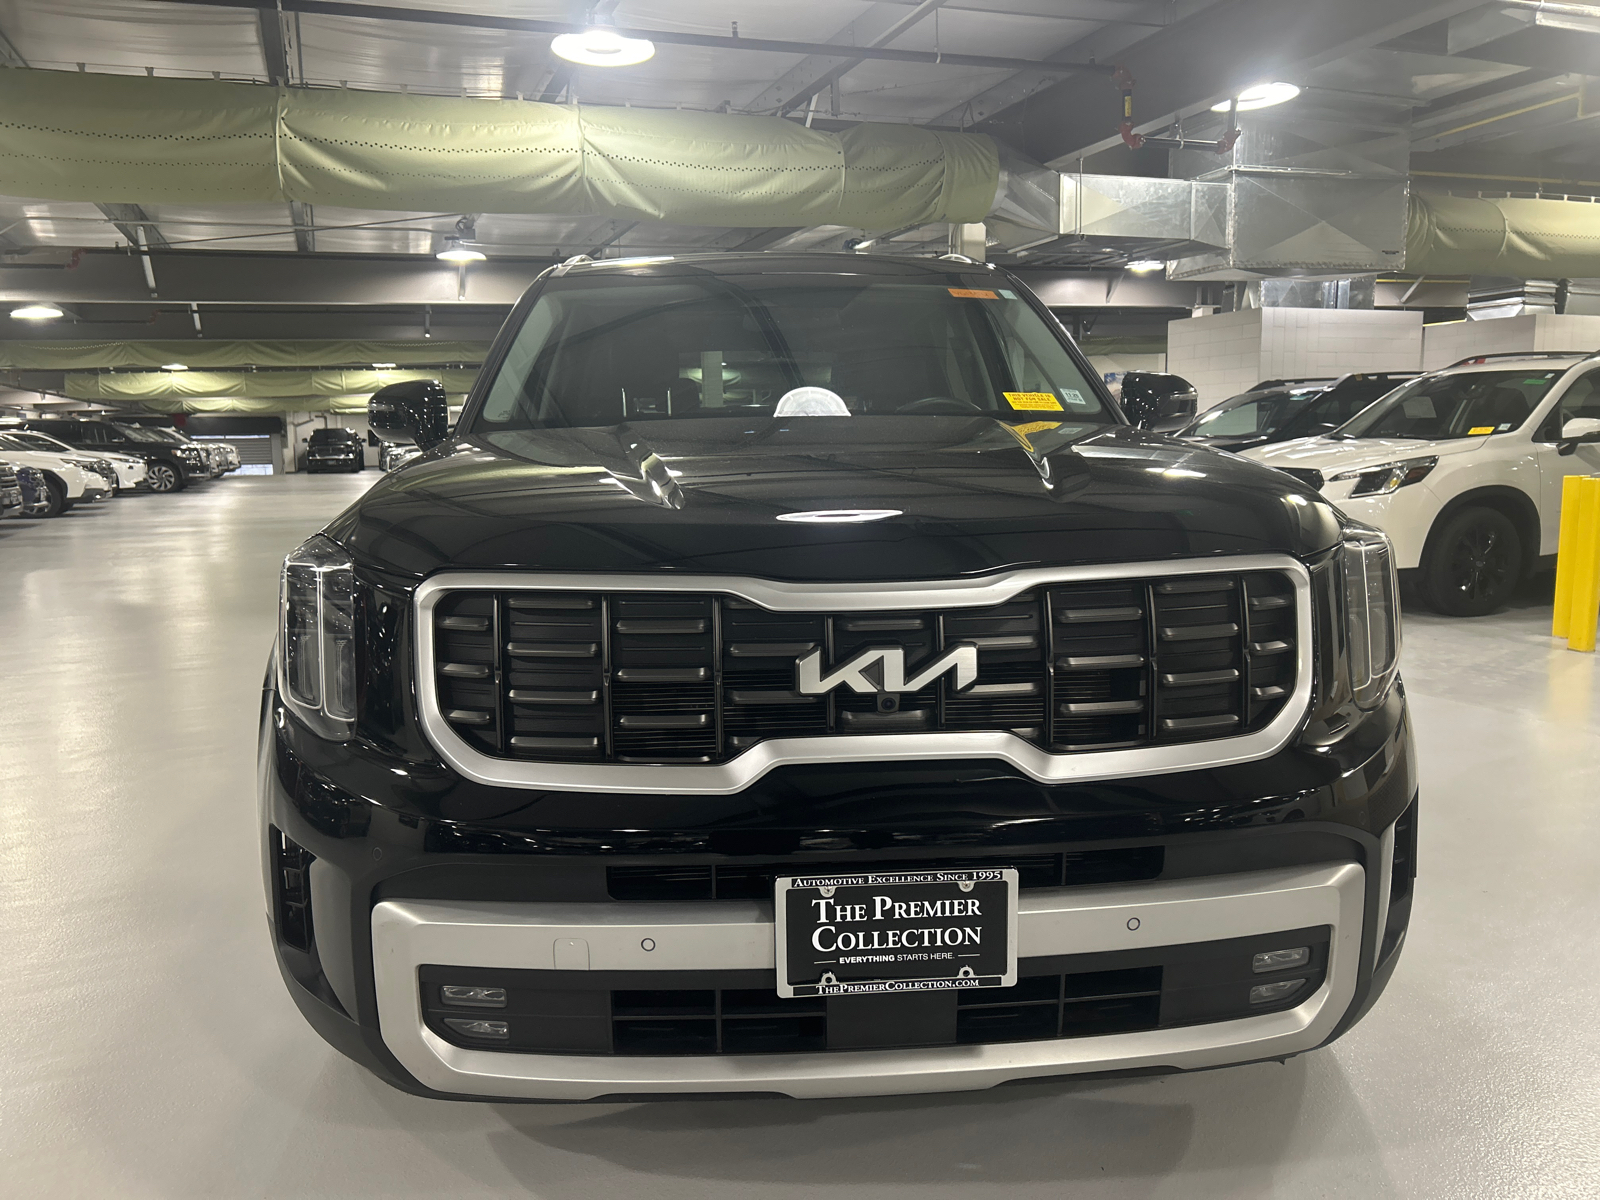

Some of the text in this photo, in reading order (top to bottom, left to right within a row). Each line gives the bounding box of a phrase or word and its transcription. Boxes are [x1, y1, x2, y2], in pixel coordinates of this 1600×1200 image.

[794, 871, 1001, 887] AUTOMOTIVE EXCELLENCE SINCE 1995
[811, 896, 982, 923] THE PREMIER
[811, 926, 982, 952] COLLECTION
[839, 952, 955, 964] EVERYTHING STARTS HERE.
